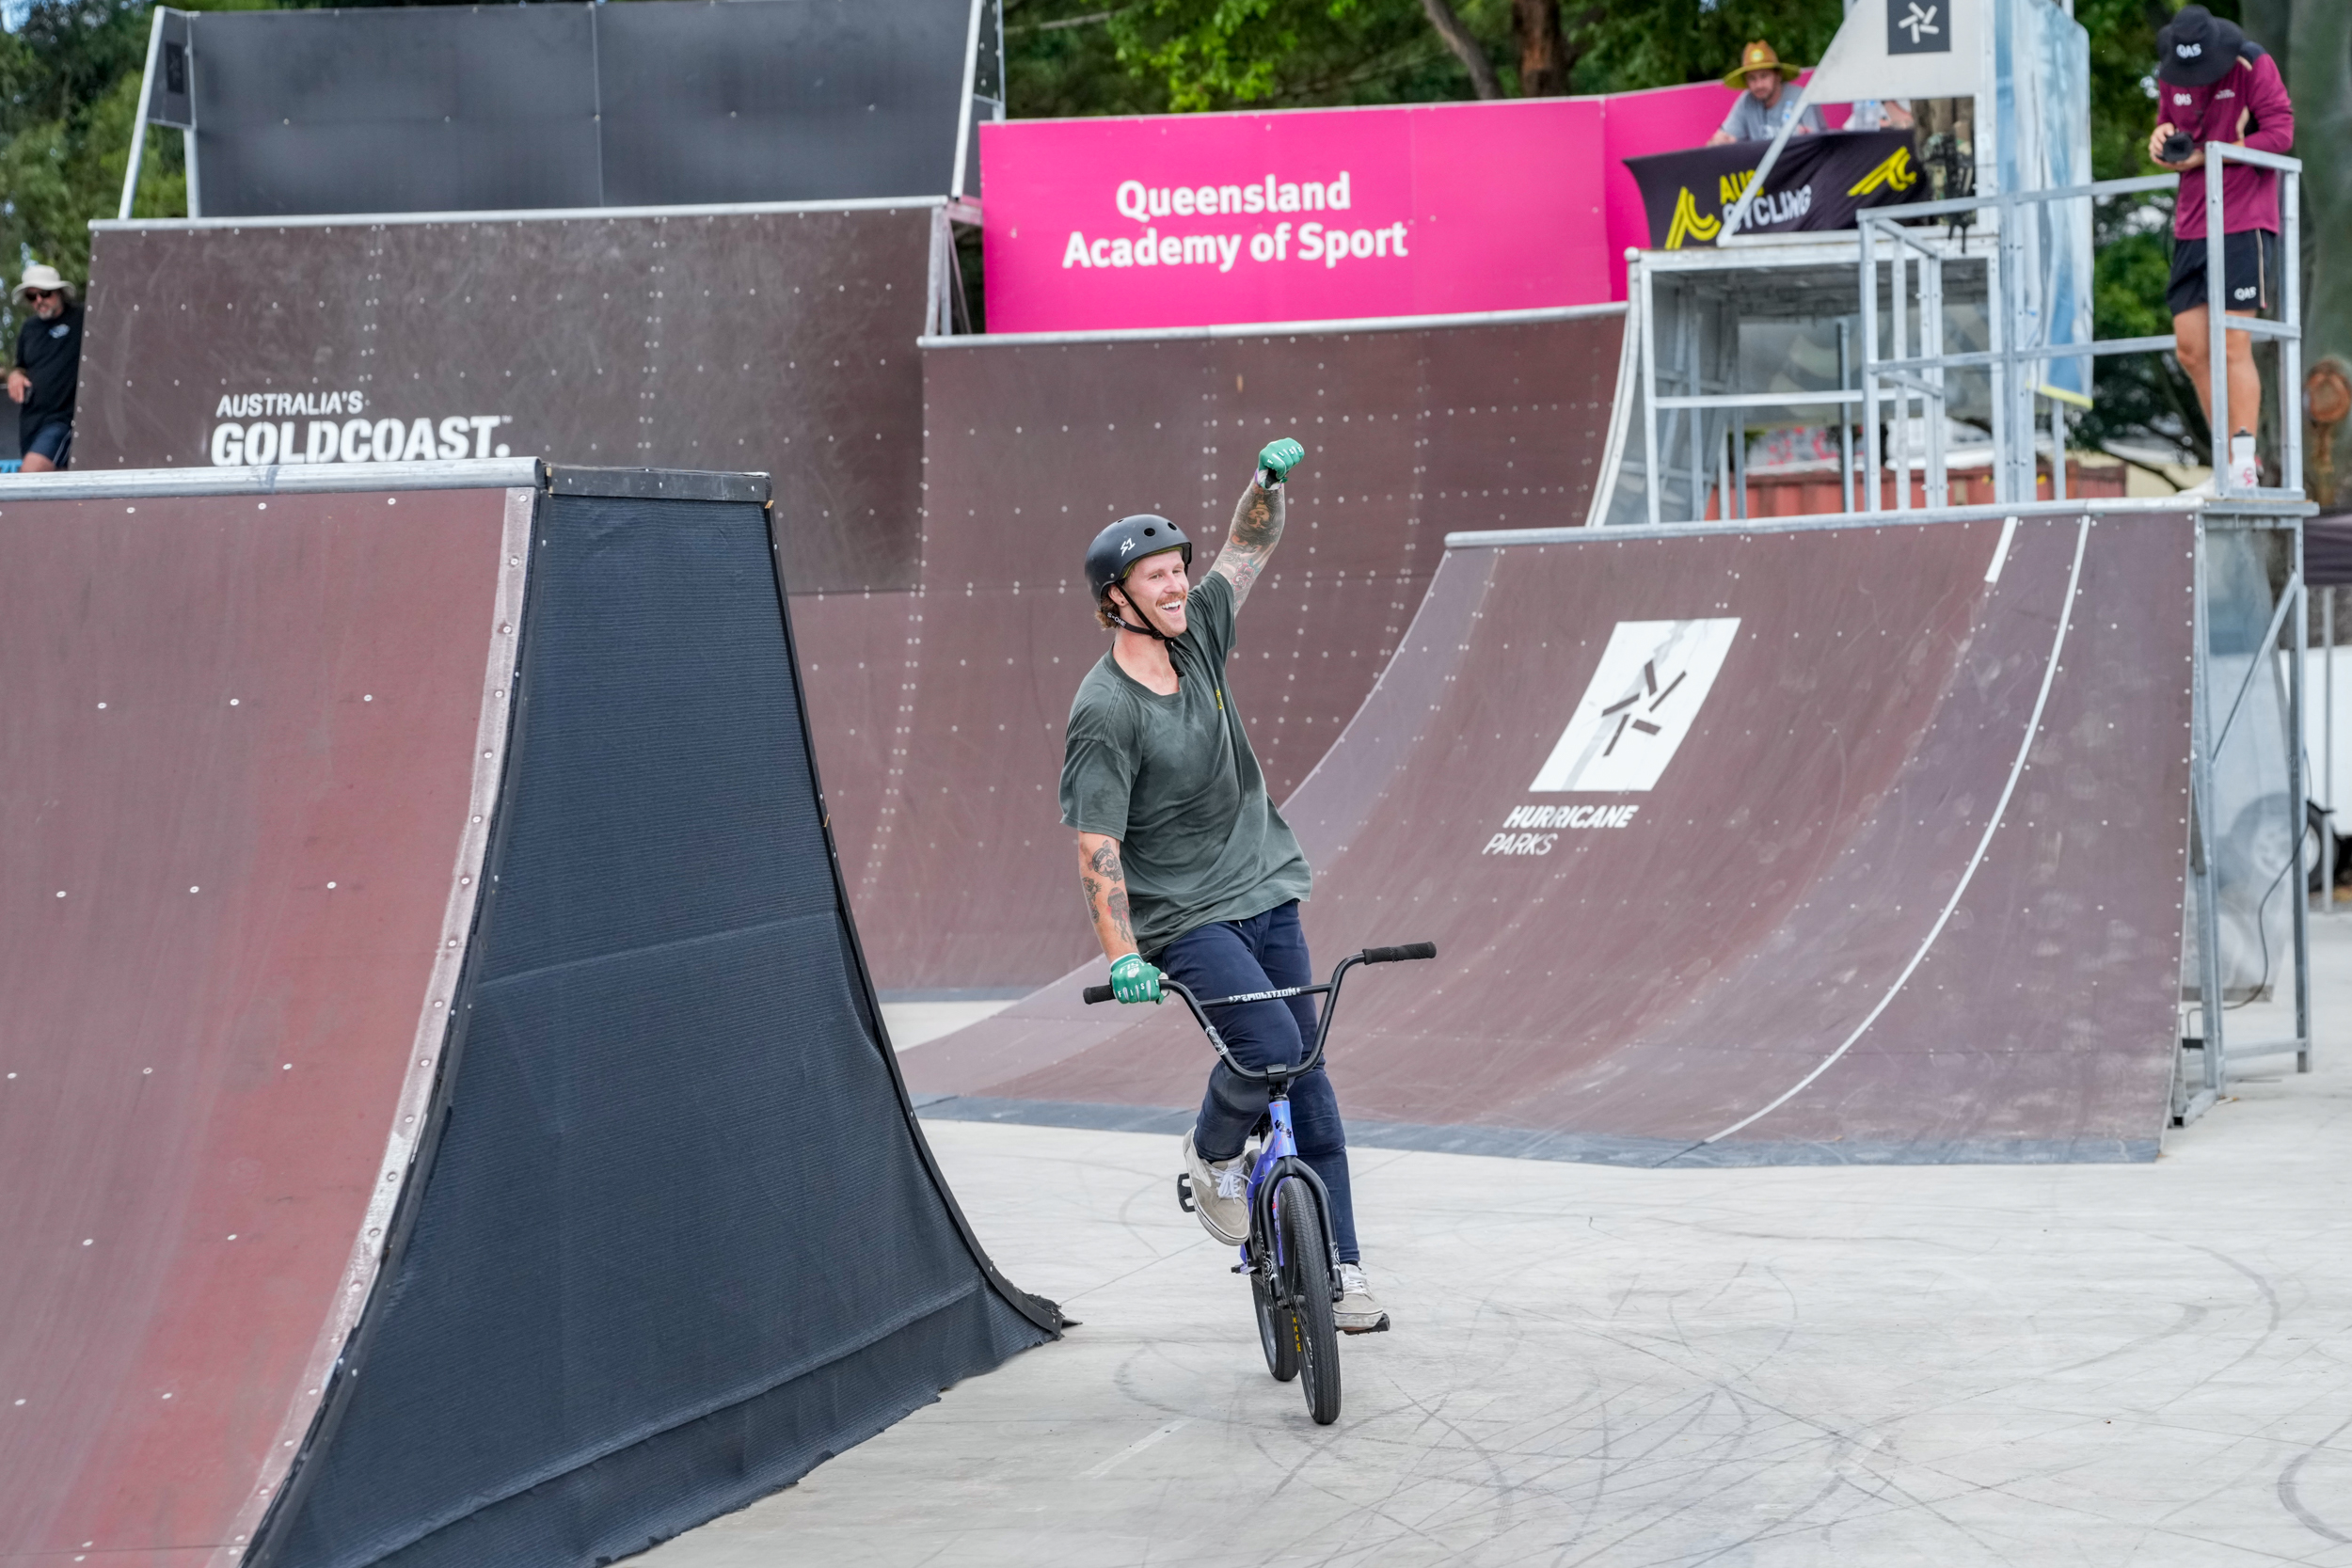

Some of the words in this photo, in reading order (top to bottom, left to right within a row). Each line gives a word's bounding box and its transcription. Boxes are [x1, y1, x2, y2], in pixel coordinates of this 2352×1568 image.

[2176, 43, 2201, 58] QAS
[1116, 170, 1351, 223] Queensland
[1062, 227, 1242, 274] Academy
[1249, 222, 1292, 262] of
[1297, 221, 1408, 269] Sport
[2233, 286, 2257, 301] QAS
[215, 390, 364, 418] AUSTRALIA'S
[1502, 805, 1640, 829] HURRICANE
[1481, 832, 1558, 855] PARKS
